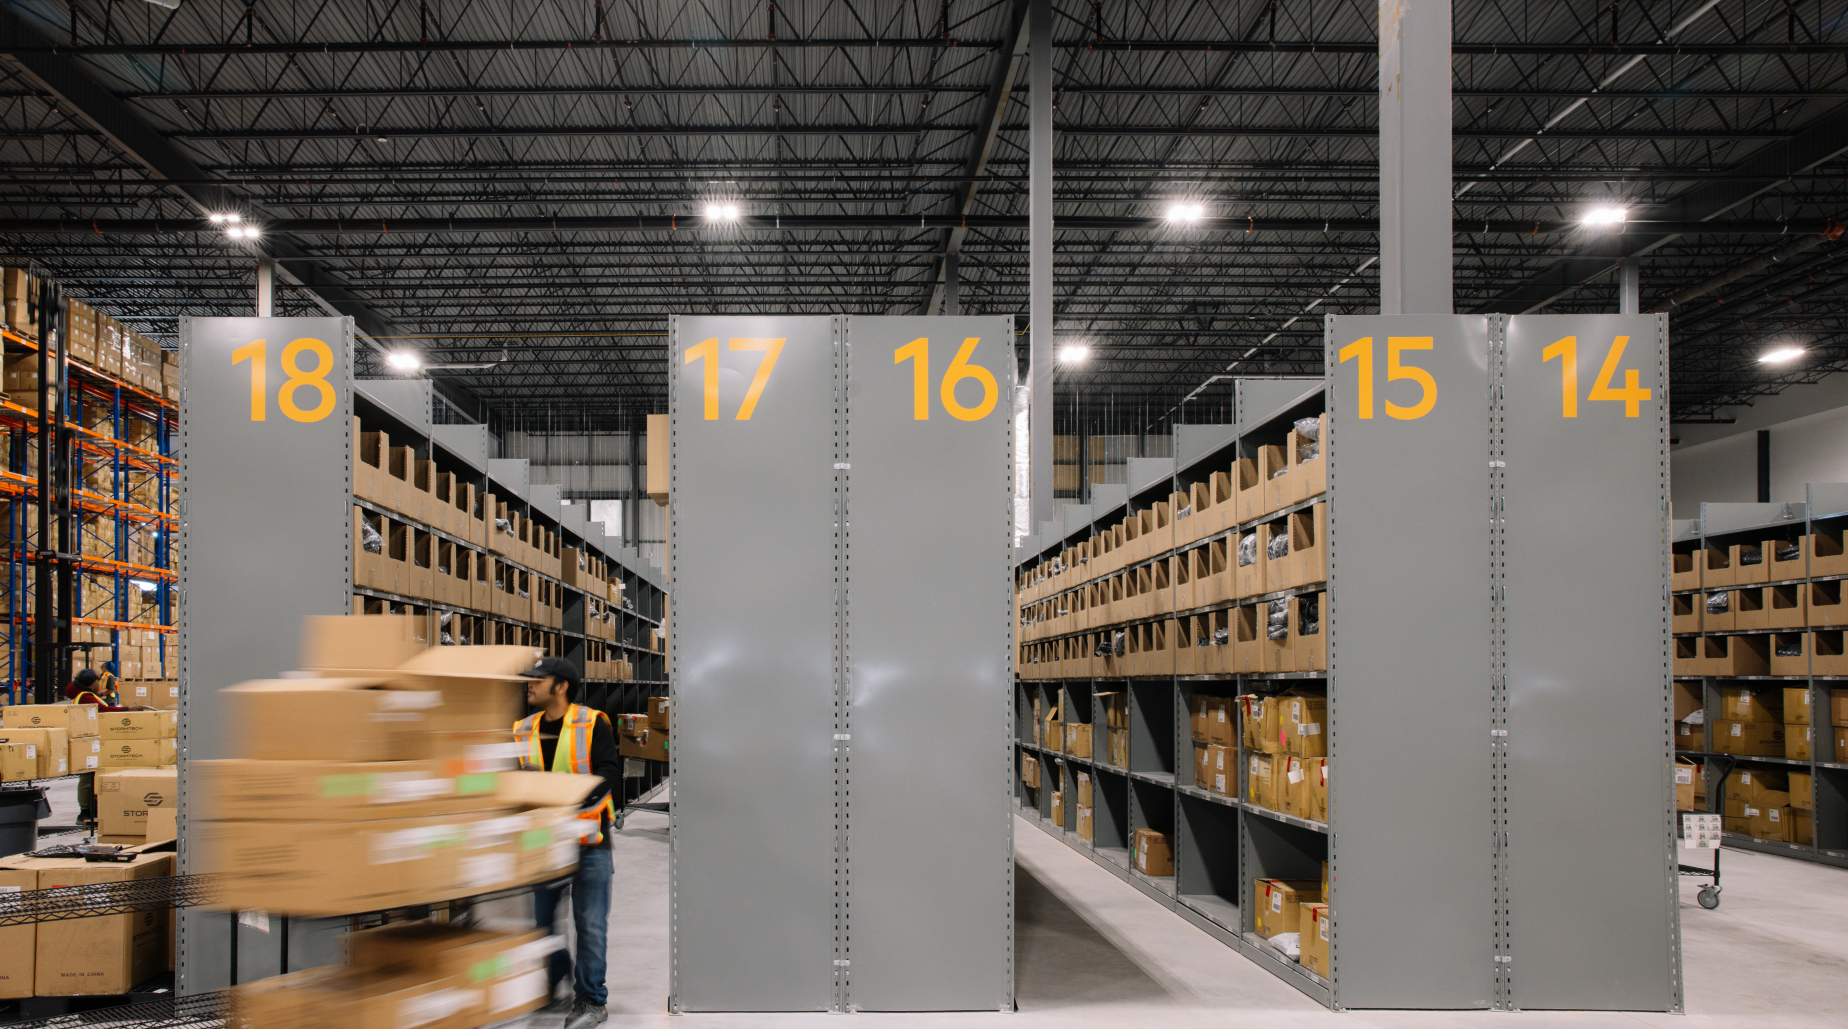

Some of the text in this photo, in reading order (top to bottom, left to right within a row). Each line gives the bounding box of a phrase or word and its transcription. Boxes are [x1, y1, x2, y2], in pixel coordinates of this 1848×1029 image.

[231, 337, 336, 422] 18
[684, 337, 787, 421] 17
[894, 337, 999, 422] 16
[1339, 336, 1438, 420] 15
[1543, 335, 1652, 418] 14
